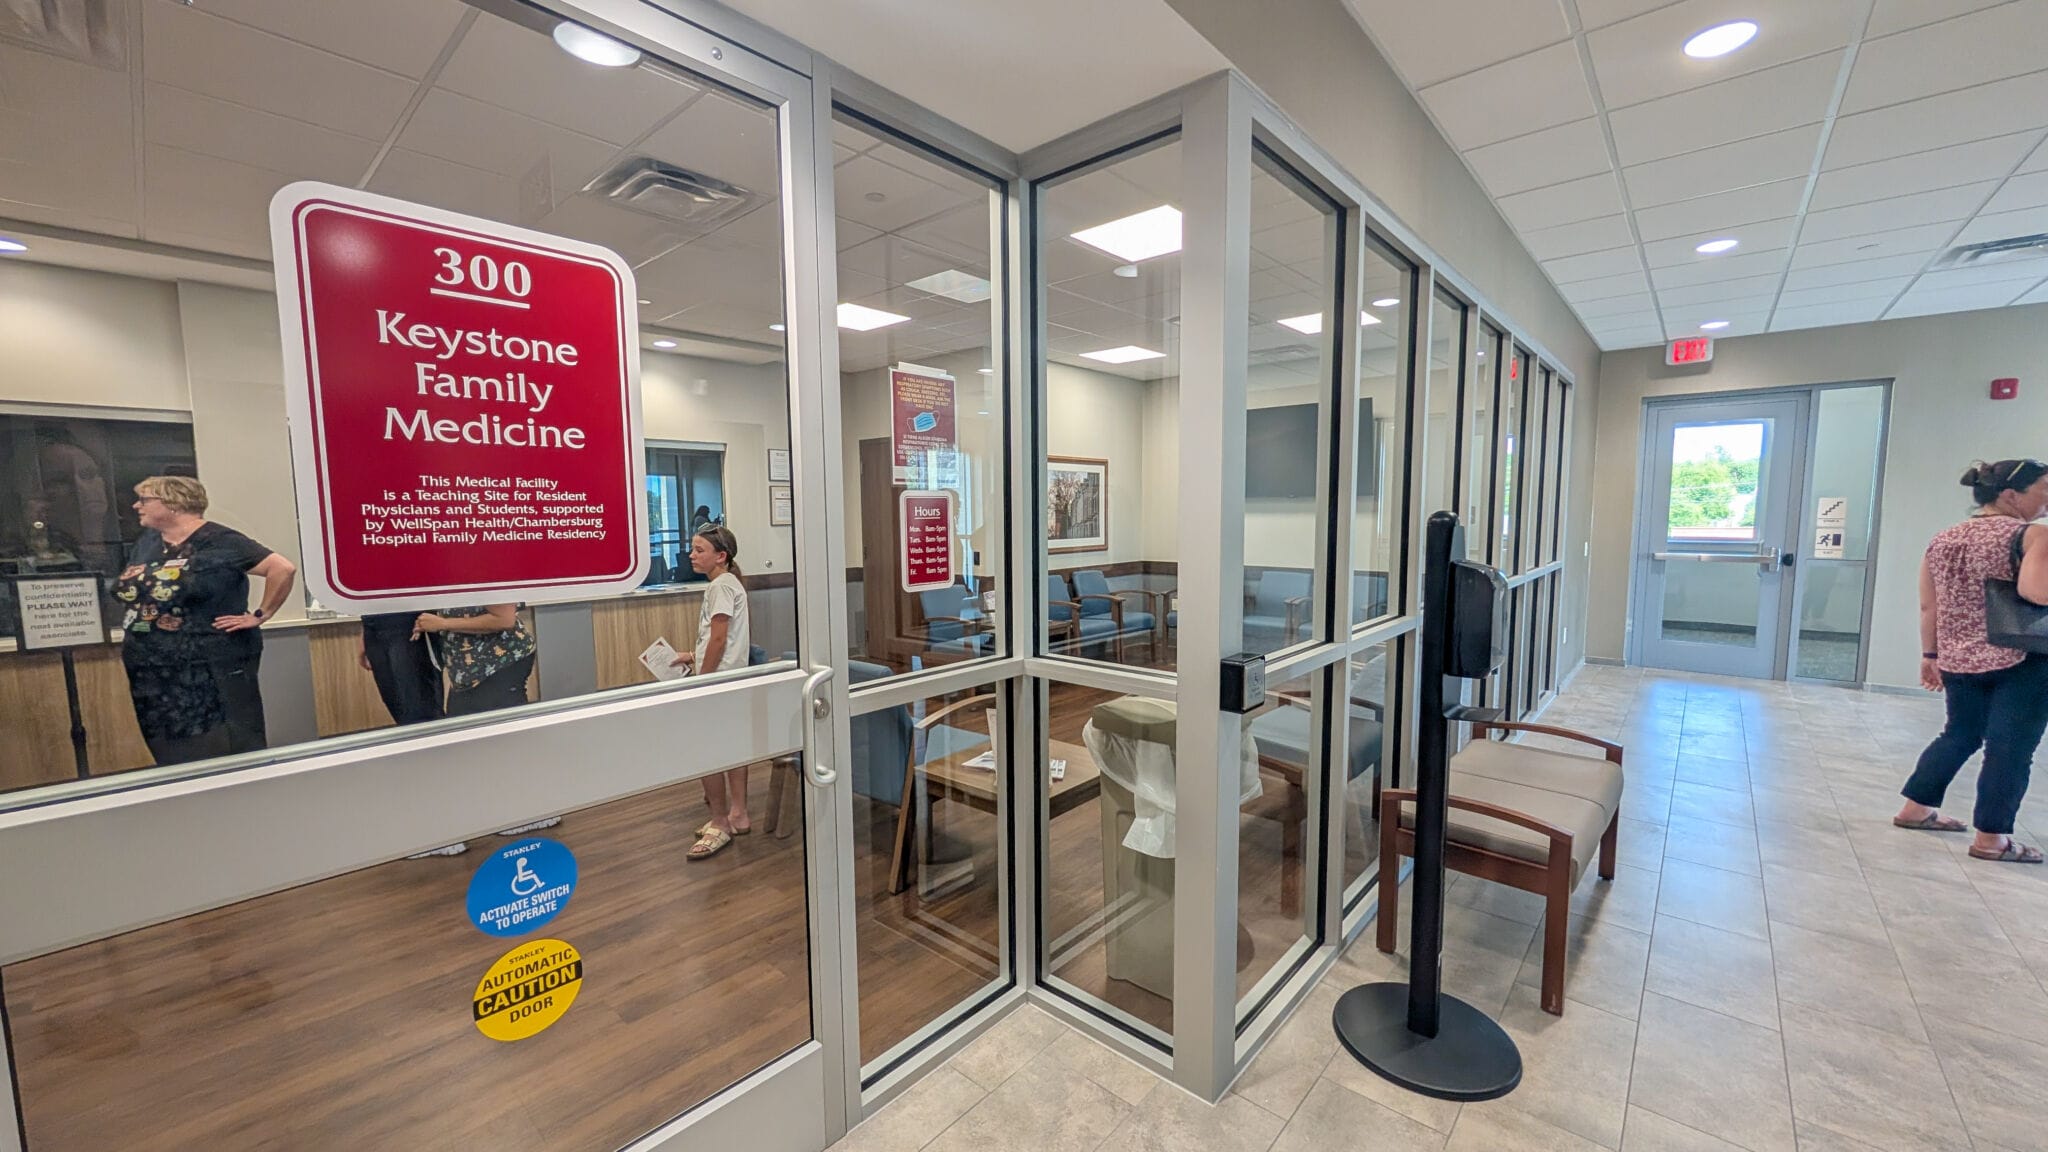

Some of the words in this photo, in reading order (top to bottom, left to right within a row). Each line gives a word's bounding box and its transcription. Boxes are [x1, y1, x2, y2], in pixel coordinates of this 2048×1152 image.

[433, 247, 532, 297] 300
[376, 309, 579, 366] Keystone
[415, 362, 553, 412] Family
[383, 407, 586, 449] Medicine
[419, 475, 450, 487] This
[455, 476, 511, 488] Medical
[515, 477, 558, 490] Facility
[383, 489, 396, 501] is
[401, 492, 411, 501] a
[415, 489, 480, 504] Teaching
[484, 490, 509, 501] Site
[513, 490, 532, 501] for
[536, 490, 587, 501] Resident
[361, 504, 441, 518] Physicians
[445, 504, 473, 515] and
[477, 503, 538, 515] Students,
[542, 503, 604, 516] supported
[914, 506, 941, 517] Hours
[365, 519, 384, 532] by
[390, 518, 460, 531] WellSpan
[465, 516, 603, 529] Health/Chambersburg
[362, 532, 427, 547] Hospital
[432, 531, 478, 544] Family
[482, 530, 543, 541] Medicine
[547, 529, 606, 540] Residency
[44, 582, 85, 590] preserve
[25, 591, 93, 601] confidentiality
[27, 602, 66, 610] PLEASE
[68, 600, 93, 608] WAIT
[53, 620, 96, 629] available
[503, 842, 542, 859] STANLEY
[480, 898, 529, 924] ACTIVATE
[531, 884, 570, 907] SWITCH
[496, 916, 510, 931] TO
[512, 900, 557, 926] OPERATE
[509, 946, 546, 965] STANLEY
[482, 948, 573, 992] AUTOMATIC
[478, 963, 577, 1017] CAUTION
[509, 996, 554, 1024] DOOR
